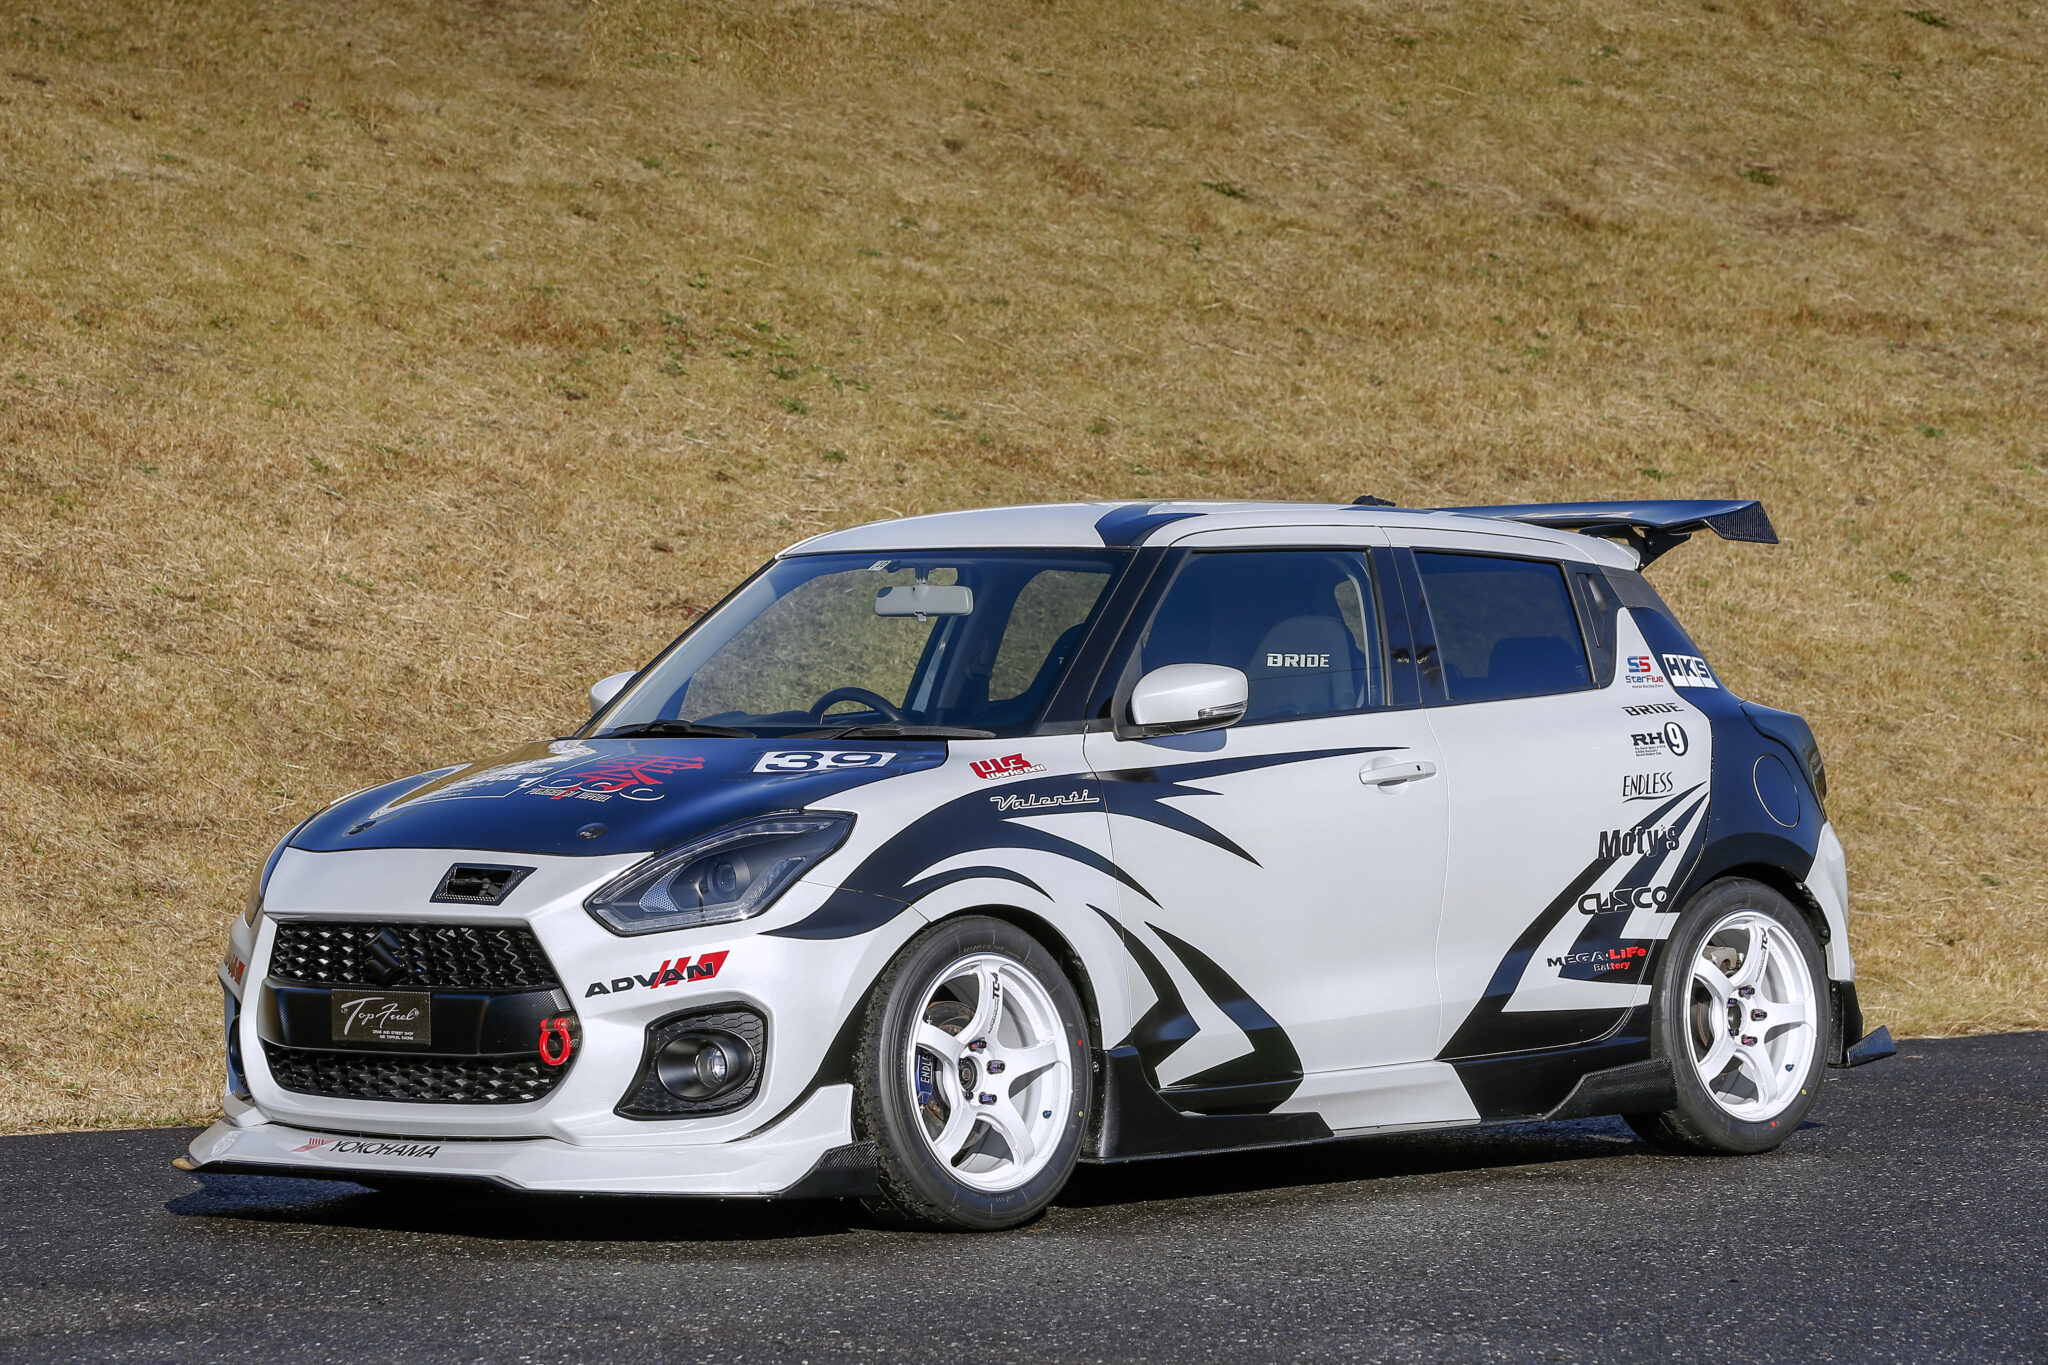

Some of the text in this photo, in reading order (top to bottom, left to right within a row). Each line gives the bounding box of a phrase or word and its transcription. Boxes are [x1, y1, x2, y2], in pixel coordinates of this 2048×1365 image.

[1266, 653, 1330, 668] BRIDE
[1664, 656, 1711, 679] HKS
[1621, 702, 1685, 717] BRIDE
[764, 751, 883, 771] 39
[986, 763, 1048, 780] Works Bell
[1622, 771, 1674, 797] ENDLESS
[990, 789, 1100, 812] Valenti
[1597, 825, 1680, 859] Moty's
[1577, 886, 1669, 915] CUSCO
[1593, 961, 1631, 972] Battery
[584, 962, 714, 998] ADVAN
[330, 1140, 441, 1158] YOKOHAMA
